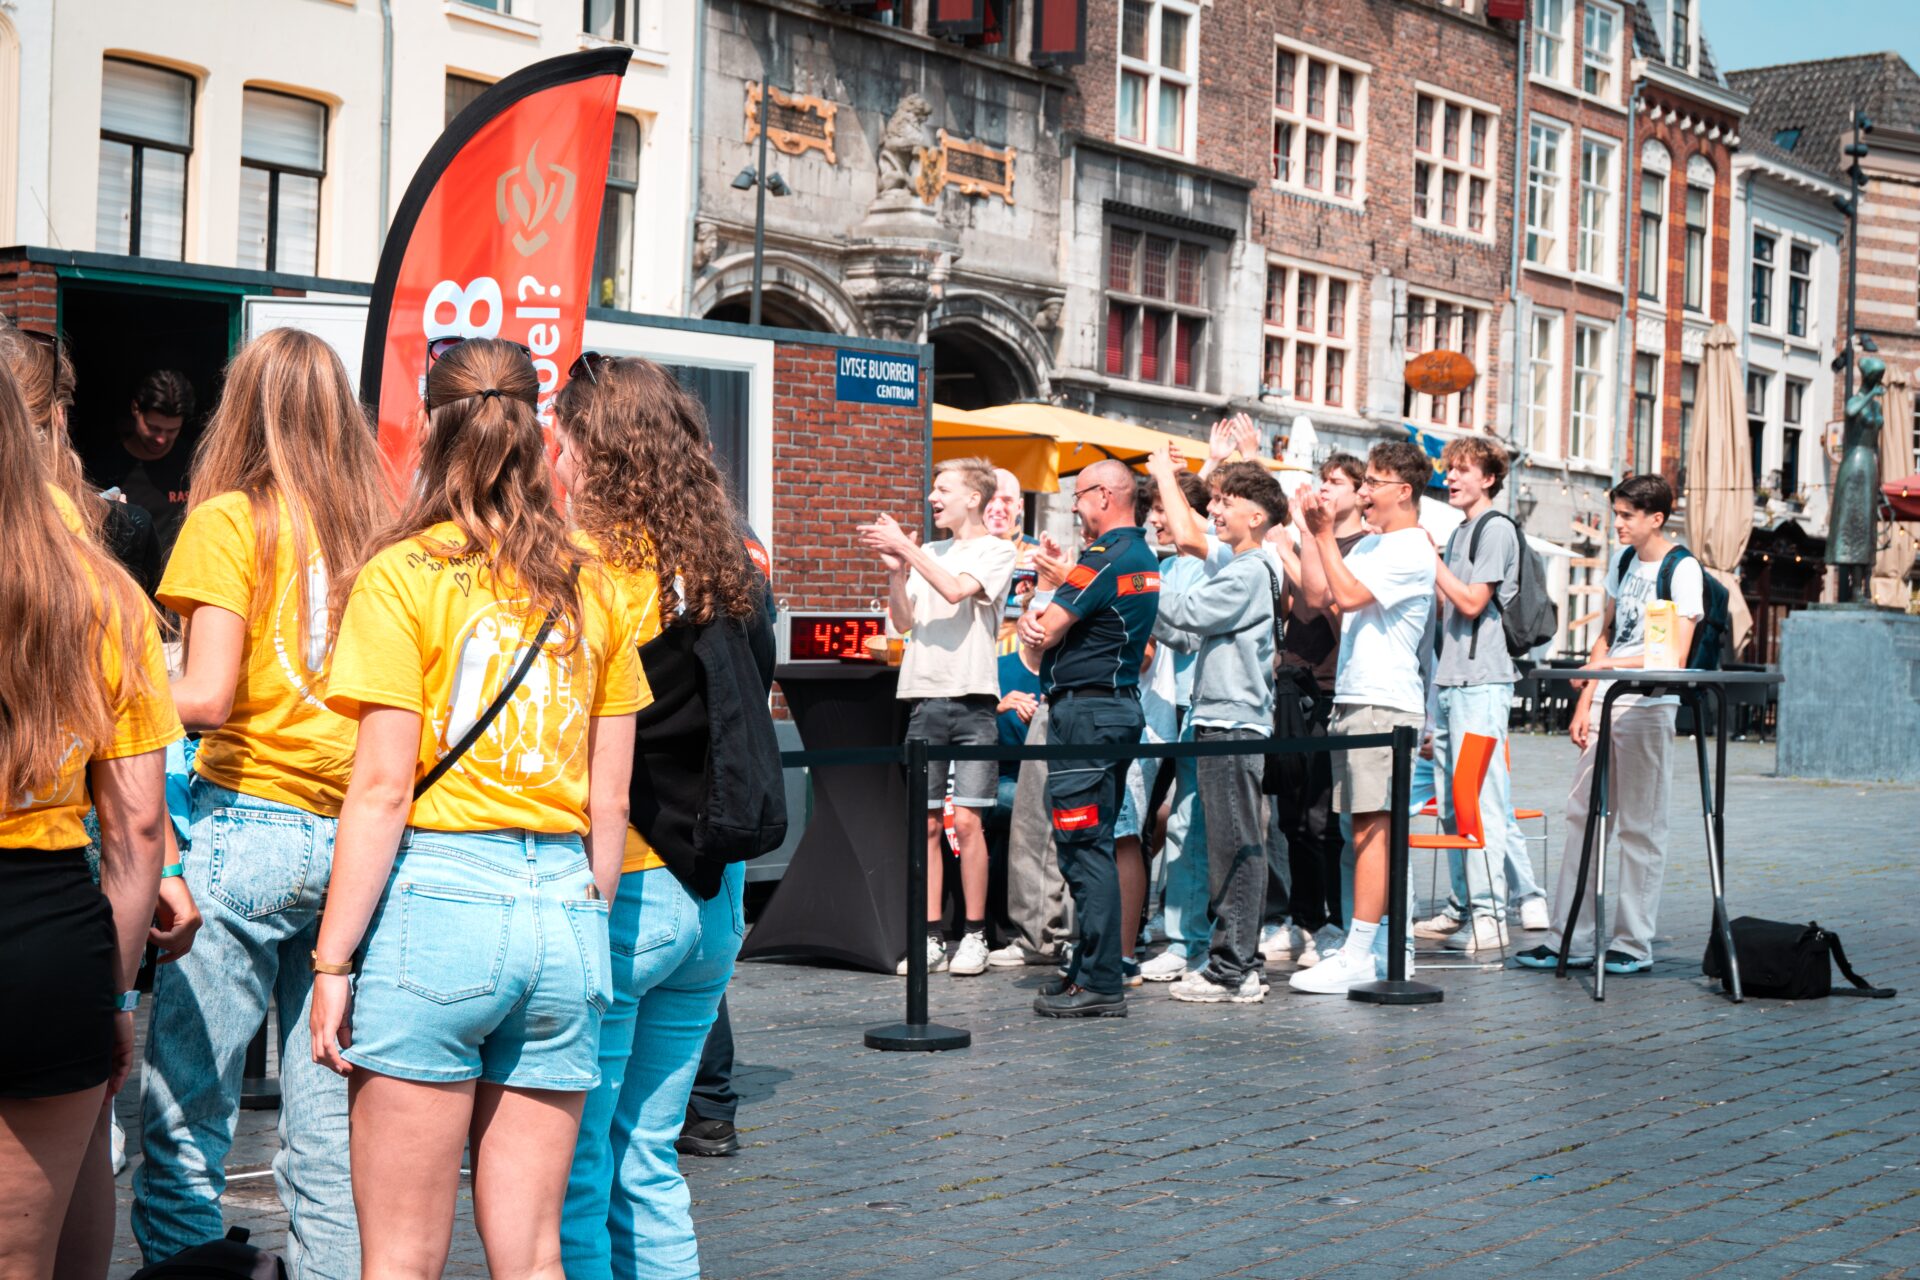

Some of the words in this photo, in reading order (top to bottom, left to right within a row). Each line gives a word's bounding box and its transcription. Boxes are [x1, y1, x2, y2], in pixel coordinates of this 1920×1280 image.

[840, 356, 867, 379] LYTSE
[868, 359, 915, 383] BUORREN
[876, 384, 915, 401] CENTRUM
